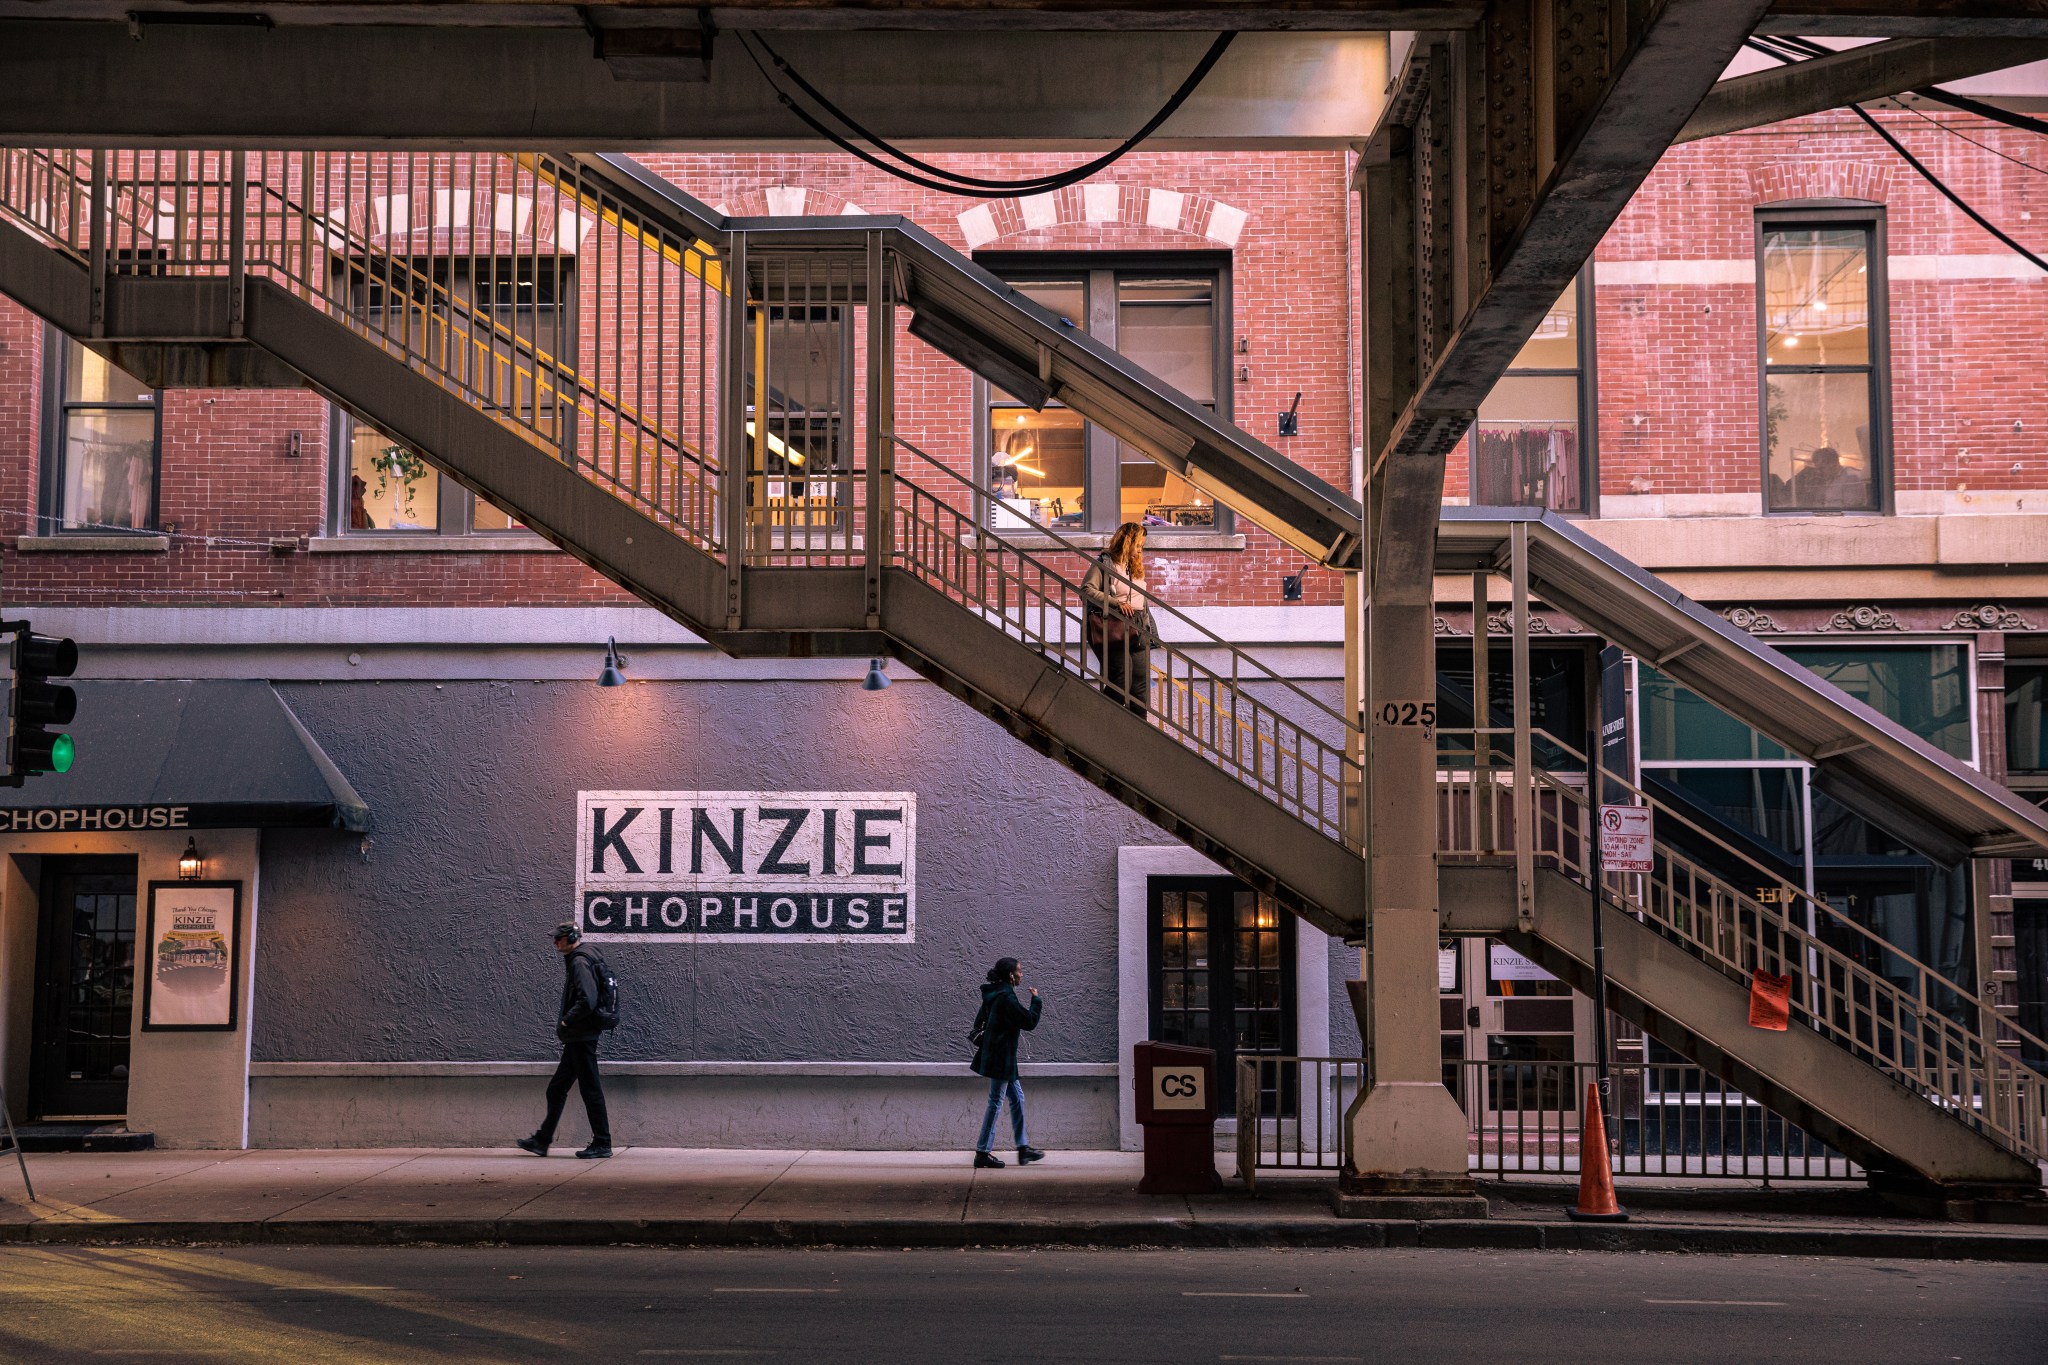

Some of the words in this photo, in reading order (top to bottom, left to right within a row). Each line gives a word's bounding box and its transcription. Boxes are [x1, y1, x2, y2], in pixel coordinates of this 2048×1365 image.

[590, 806, 902, 879] KINZIE
[588, 897, 904, 929] CHOPHOUSE
[1493, 957, 1524, 966] KINZIE
[1161, 1074, 1197, 1098] CS
